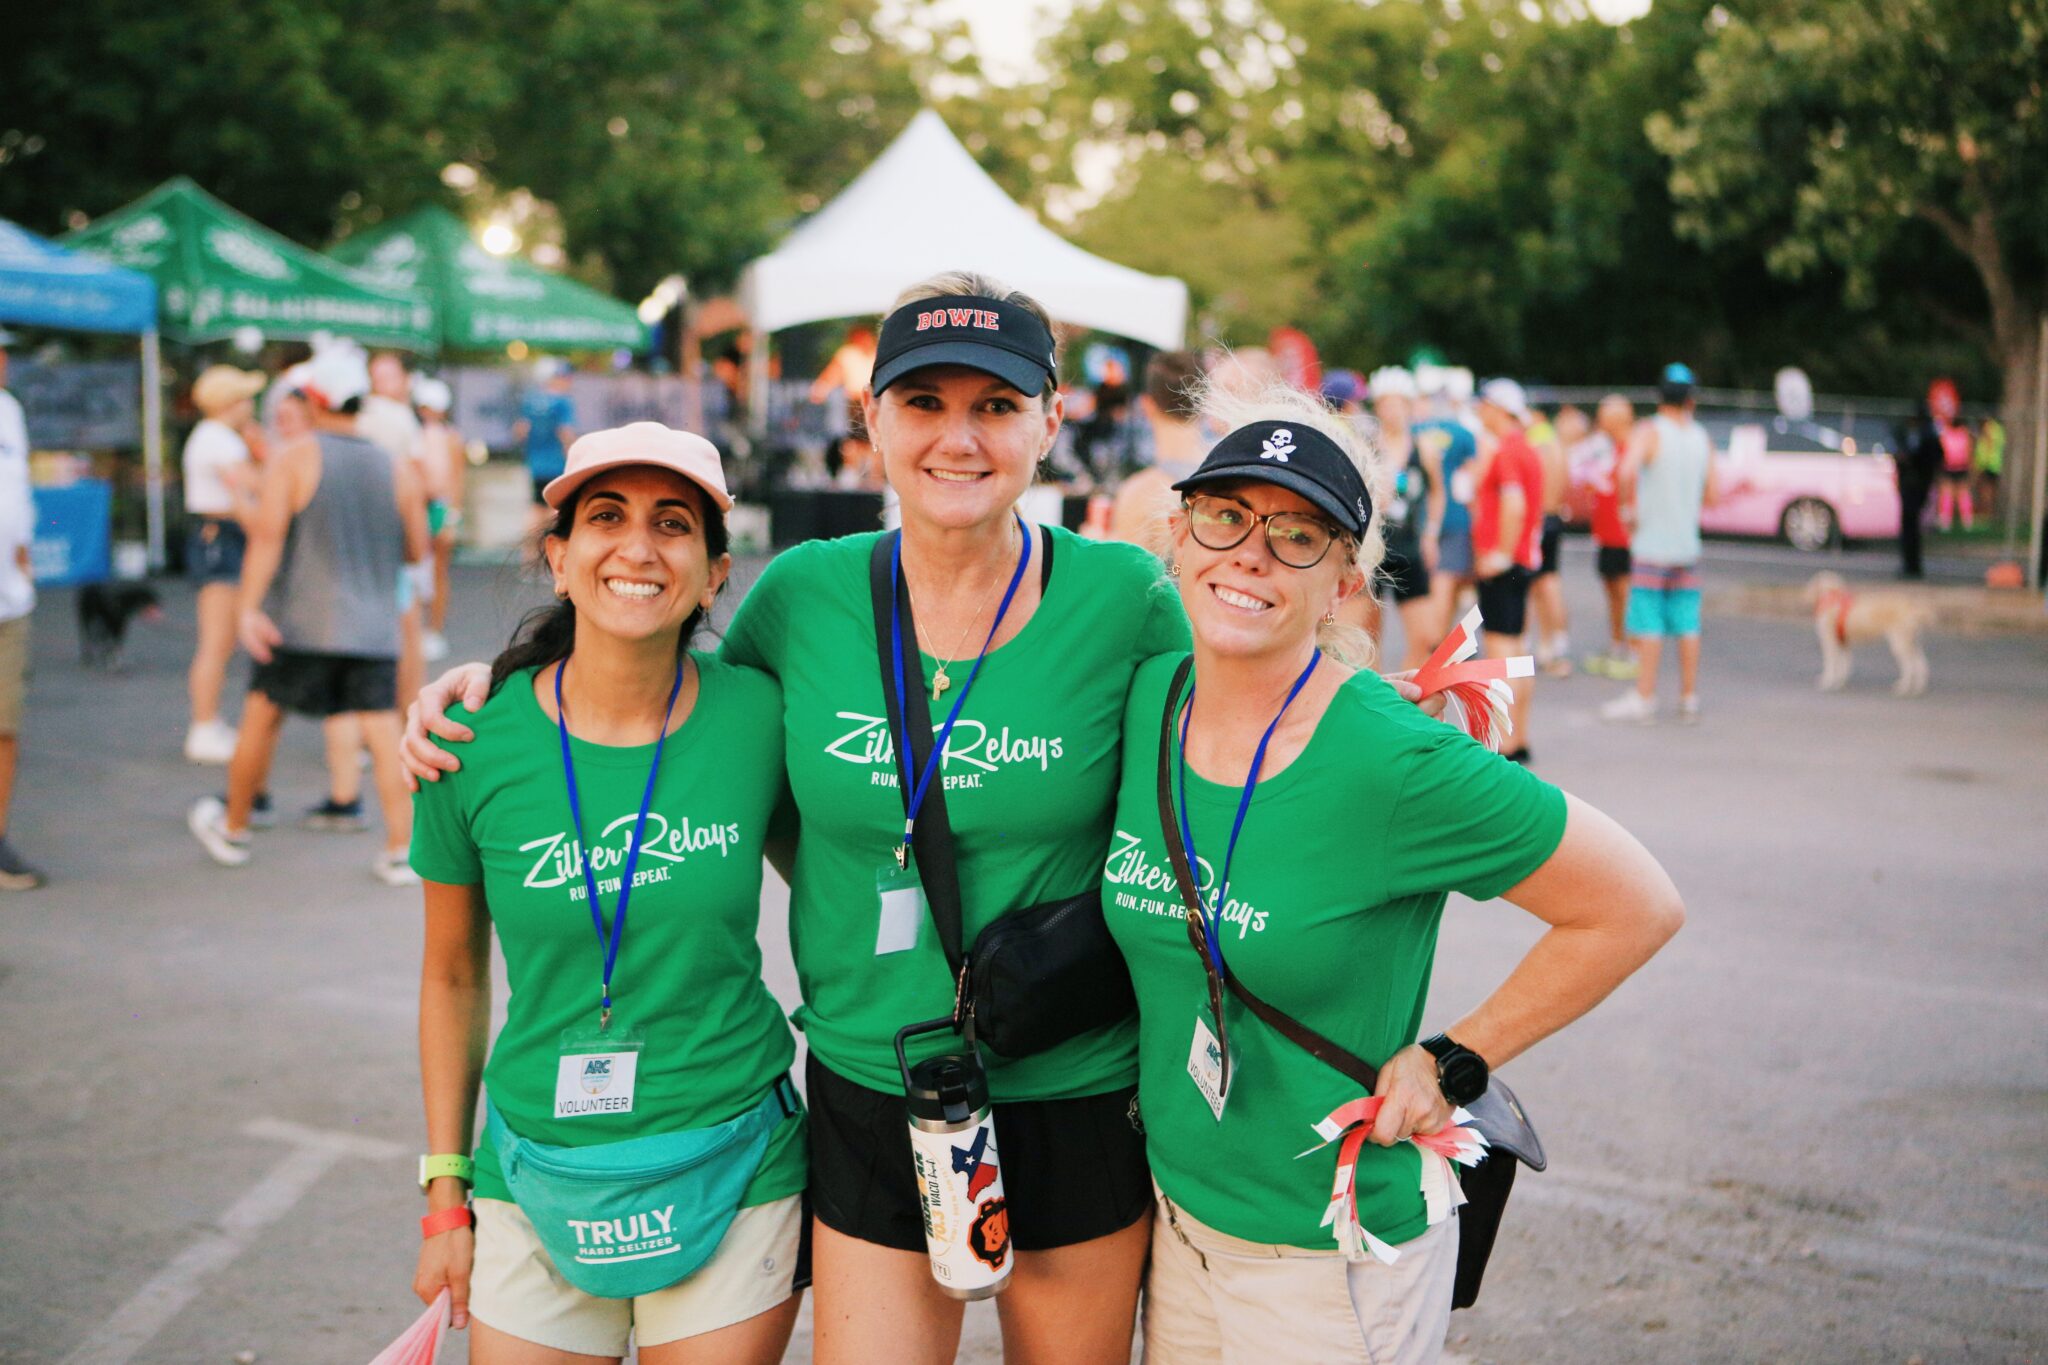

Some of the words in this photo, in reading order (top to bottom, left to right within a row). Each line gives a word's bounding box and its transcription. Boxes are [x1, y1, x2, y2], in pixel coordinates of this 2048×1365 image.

[916, 308, 1000, 331] BOWIE
[824, 711, 898, 764] Zil
[932, 719, 1064, 772] Relays
[519, 831, 623, 889] Zilker
[601, 812, 740, 862] Relays
[1104, 830, 1177, 893] Zilker
[559, 1097, 629, 1114] VOLUNTEER
[928, 1180, 942, 1208] WACO
[579, 1247, 615, 1256] HARD
[617, 1236, 673, 1254] SELTZER
